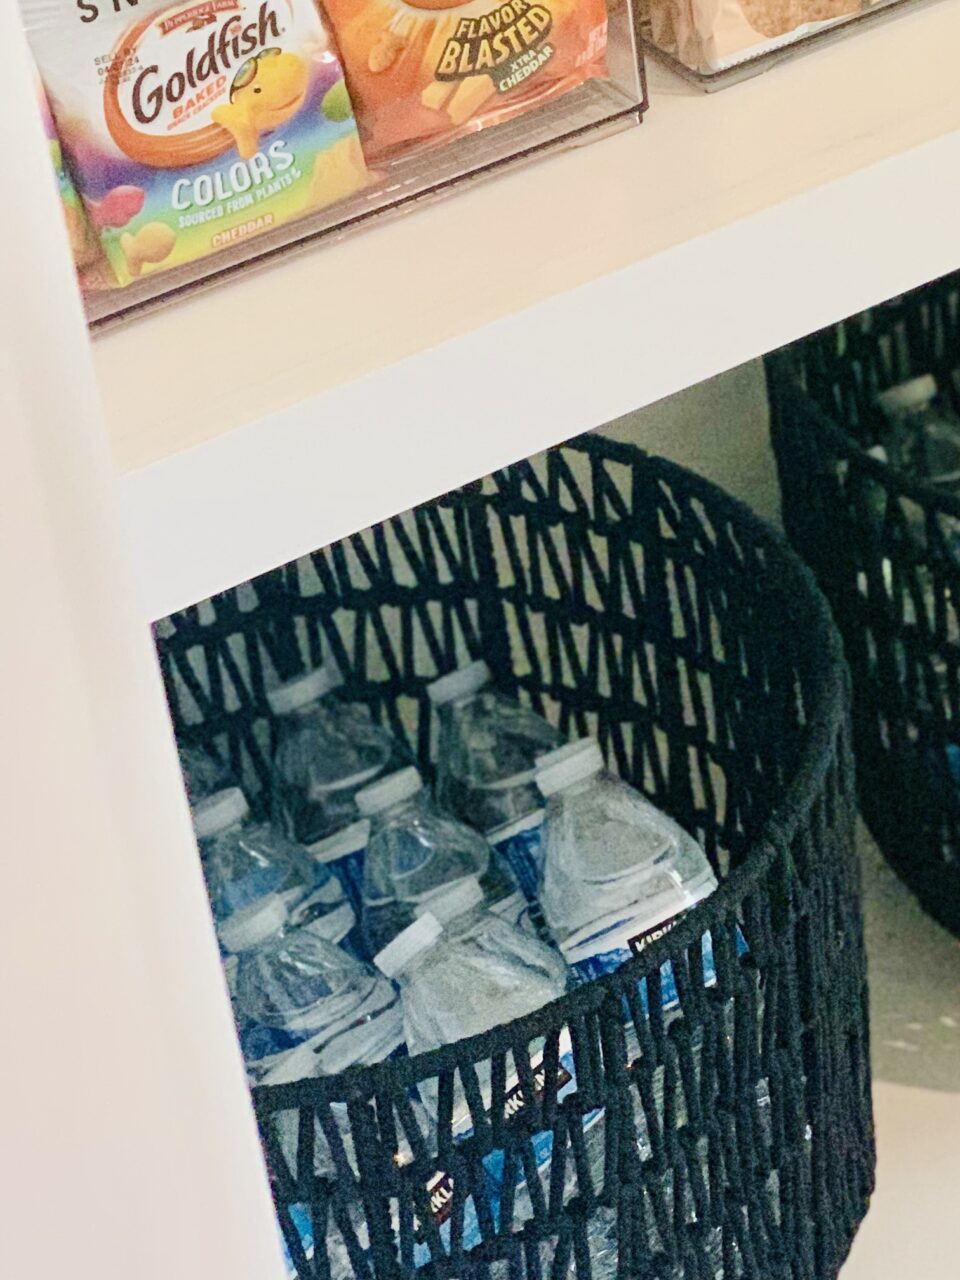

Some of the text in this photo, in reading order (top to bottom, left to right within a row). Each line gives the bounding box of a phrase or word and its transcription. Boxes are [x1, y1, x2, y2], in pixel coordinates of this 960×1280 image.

[132, 1, 280, 125] Goldfish
[437, 6, 551, 75] BLASTED
[509, 48, 537, 73] XTRA
[499, 45, 554, 92] CHEDDAR
[171, 75, 227, 120] BAKED
[171, 140, 295, 212] COLORS
[178, 176, 293, 229] SOURCED FROM PLANTS
[212, 214, 275, 248] CHEDDAR
